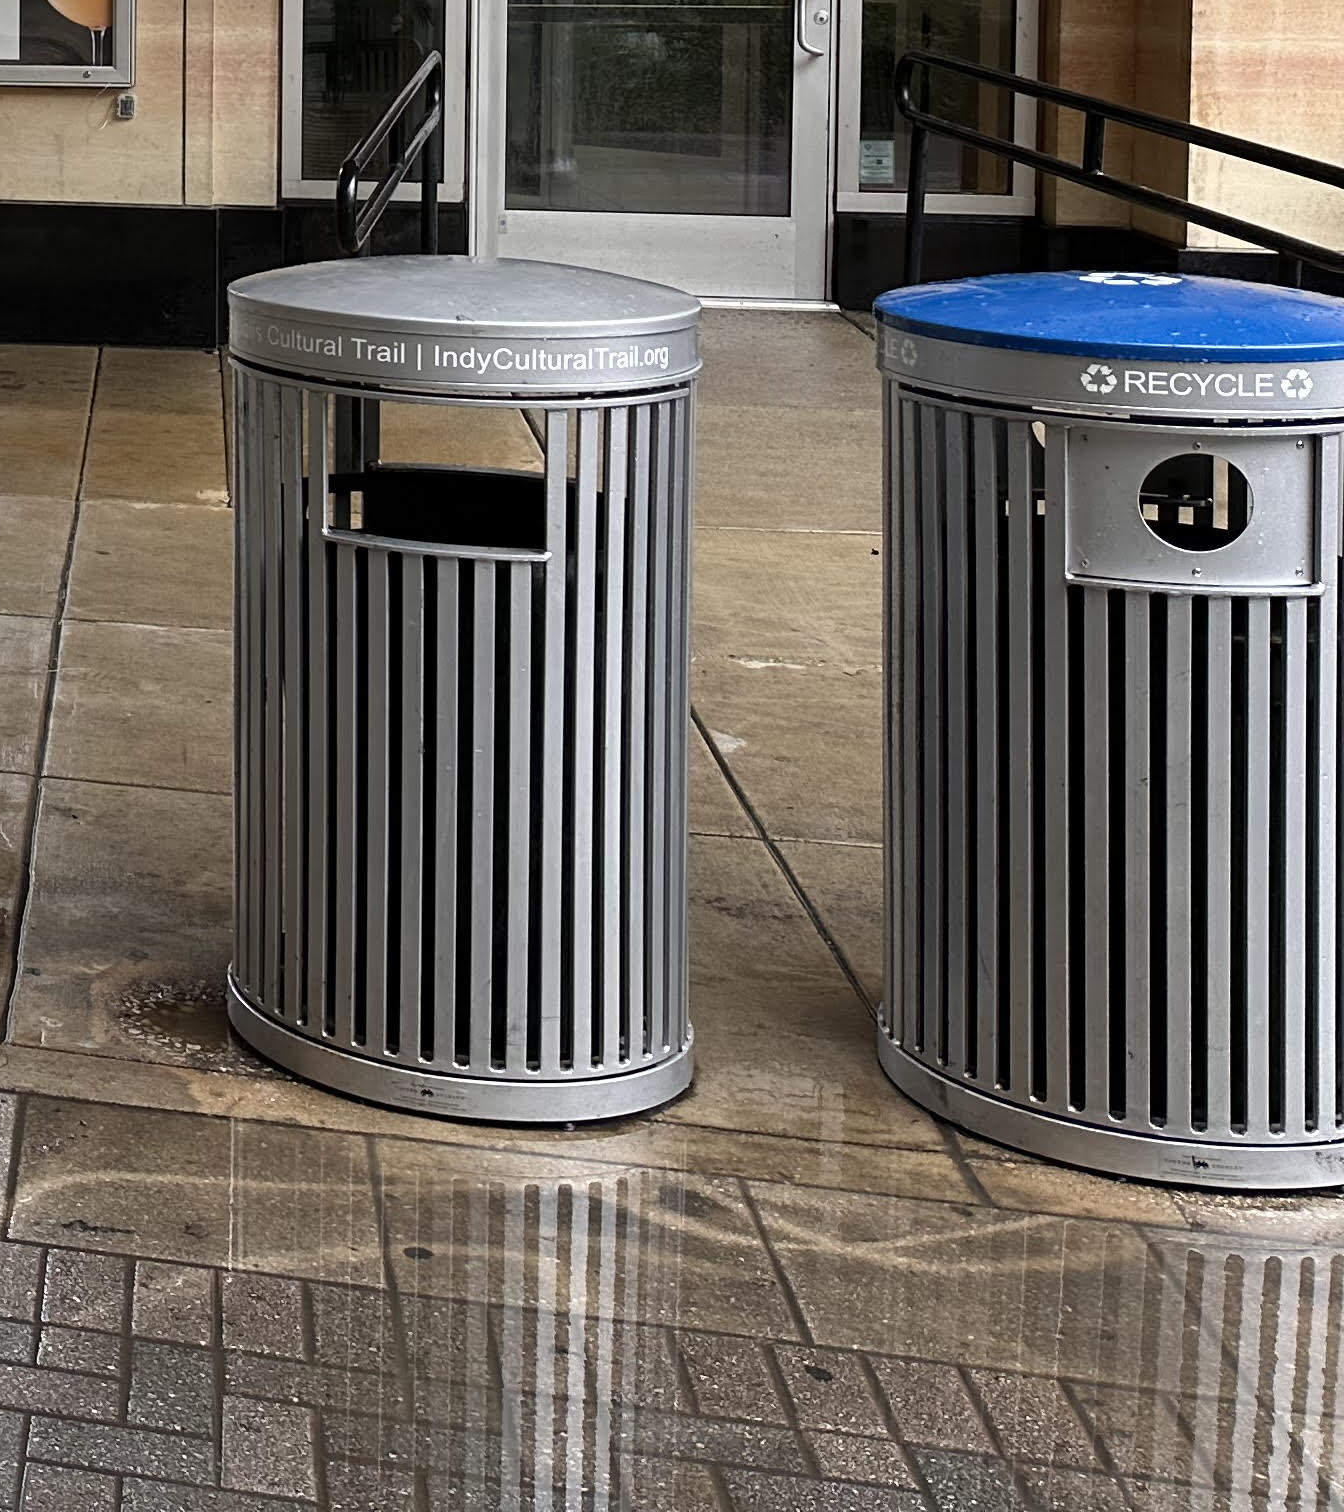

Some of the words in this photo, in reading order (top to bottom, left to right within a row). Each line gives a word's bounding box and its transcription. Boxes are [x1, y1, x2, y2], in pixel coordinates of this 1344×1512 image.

[267, 324, 343, 357] Cultural
[350, 336, 406, 364] Trail
[433, 342, 669, 375] IndyCulturalTrail.org
[1124, 369, 1274, 397] RECYCLE
